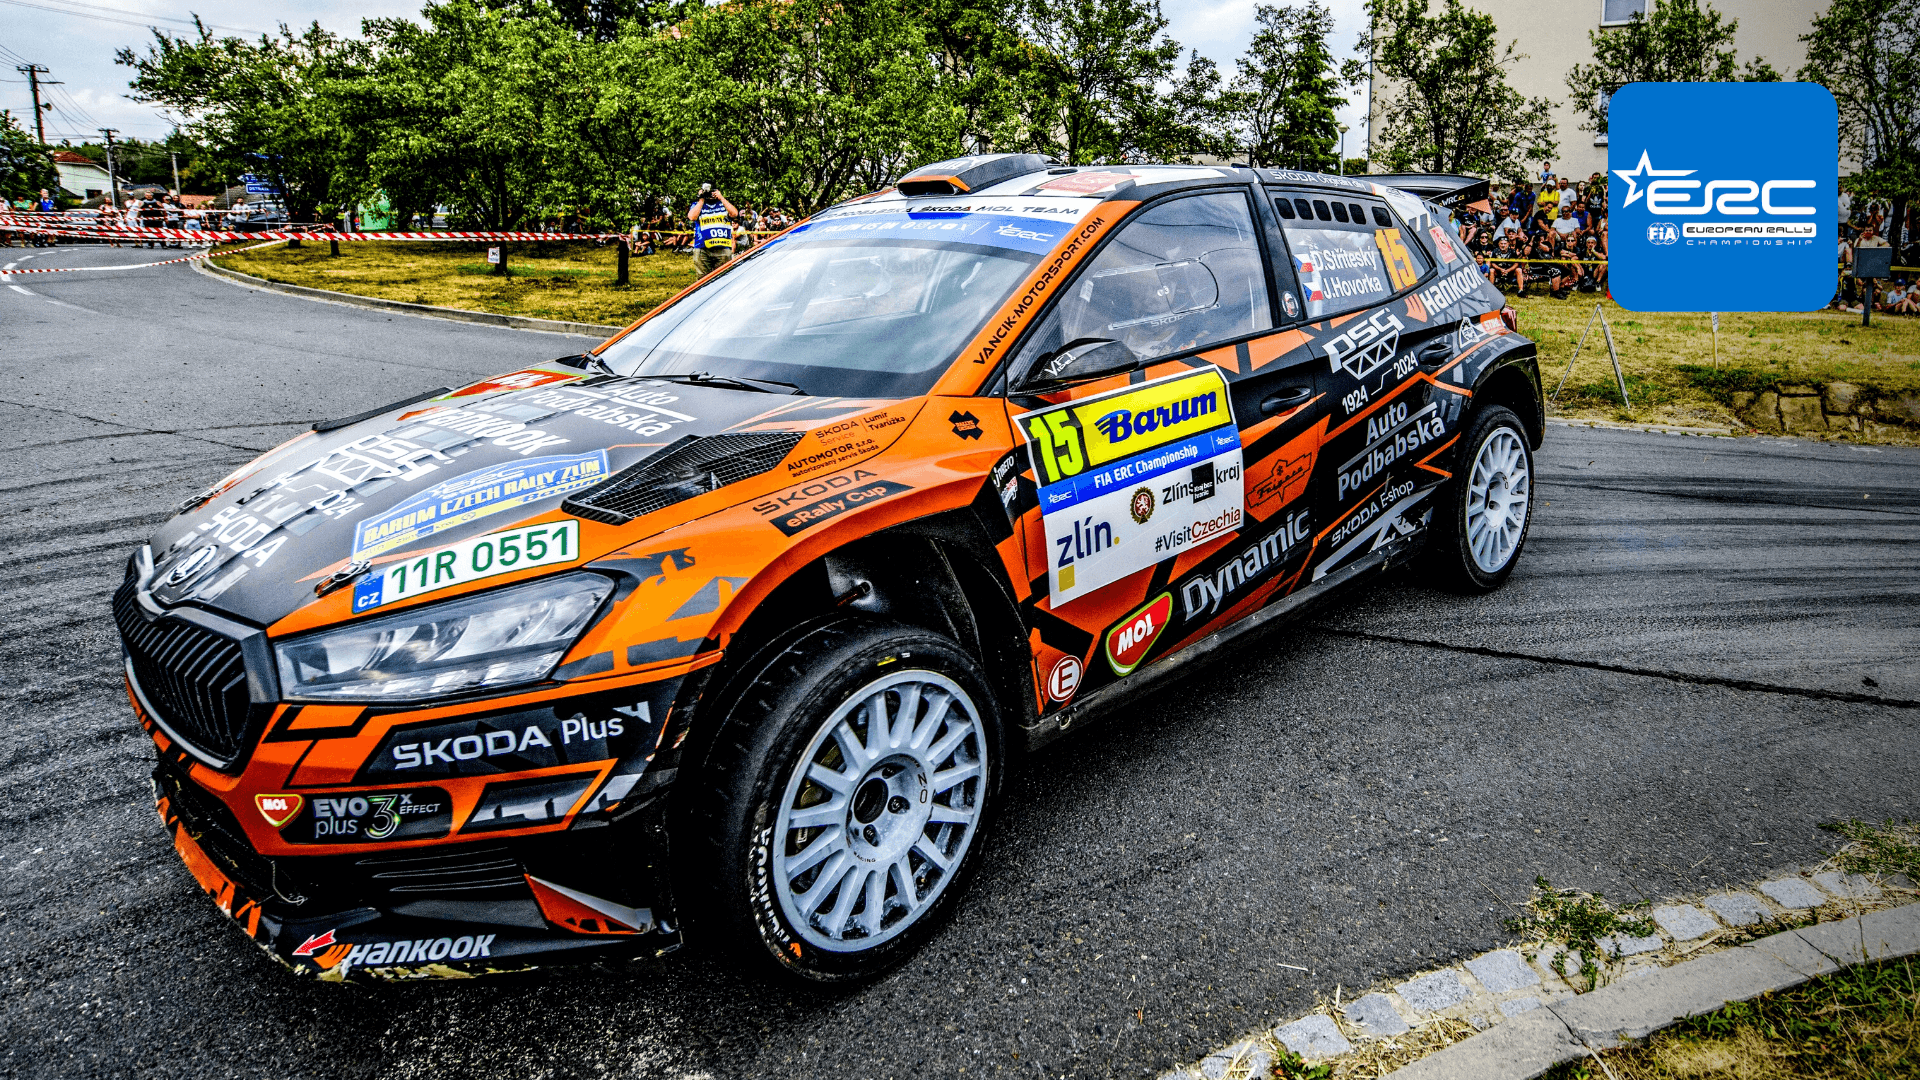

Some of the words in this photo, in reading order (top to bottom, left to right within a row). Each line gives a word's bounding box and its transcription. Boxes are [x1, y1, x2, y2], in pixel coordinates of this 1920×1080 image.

[1022, 206, 1079, 215] TEAM
[710, 229, 728, 238] 094
[1375, 228, 1418, 291] 15
[973, 217, 1106, 366] VANCIK-MOTORSPORT.COM
[1322, 274, 1383, 299] J.Hovorka
[1393, 351, 1419, 379] 2024
[600, 385, 680, 405] Auto
[1342, 385, 1369, 415] 1924
[820, 431, 855, 446] Service
[1028, 409, 1084, 483] 15
[1094, 391, 1217, 444] Barum
[1365, 401, 1408, 446] Auto
[787, 443, 854, 471] AUTOMOTOR
[856, 438, 875, 448] s.r.o.
[838, 451, 858, 462] servis
[1094, 472, 1113, 488] FIA
[1113, 463, 1135, 482] ERC
[1135, 444, 1199, 474] Championship
[1338, 410, 1446, 502] Podbabská
[1215, 461, 1240, 485] kraj
[363, 505, 436, 544] BARUM
[440, 486, 500, 515] CZECH
[504, 470, 557, 495] RALLY
[786, 499, 846, 527] eRally
[846, 486, 887, 502] Cup
[1380, 480, 1414, 508] E-shop
[1155, 506, 1241, 553] #VisitCzechia
[357, 591, 380, 608] CZ
[391, 550, 457, 594] 11R
[471, 526, 568, 573] 0551
[1183, 508, 1311, 623] Dynamic
[1116, 613, 1155, 656] MOL
[1057, 661, 1074, 694] E
[561, 716, 625, 745] Plus
[262, 798, 288, 811] MOL
[312, 796, 370, 818] EVO
[364, 794, 401, 839] 3
[399, 803, 442, 815] EFFECT
[315, 815, 359, 839] plus
